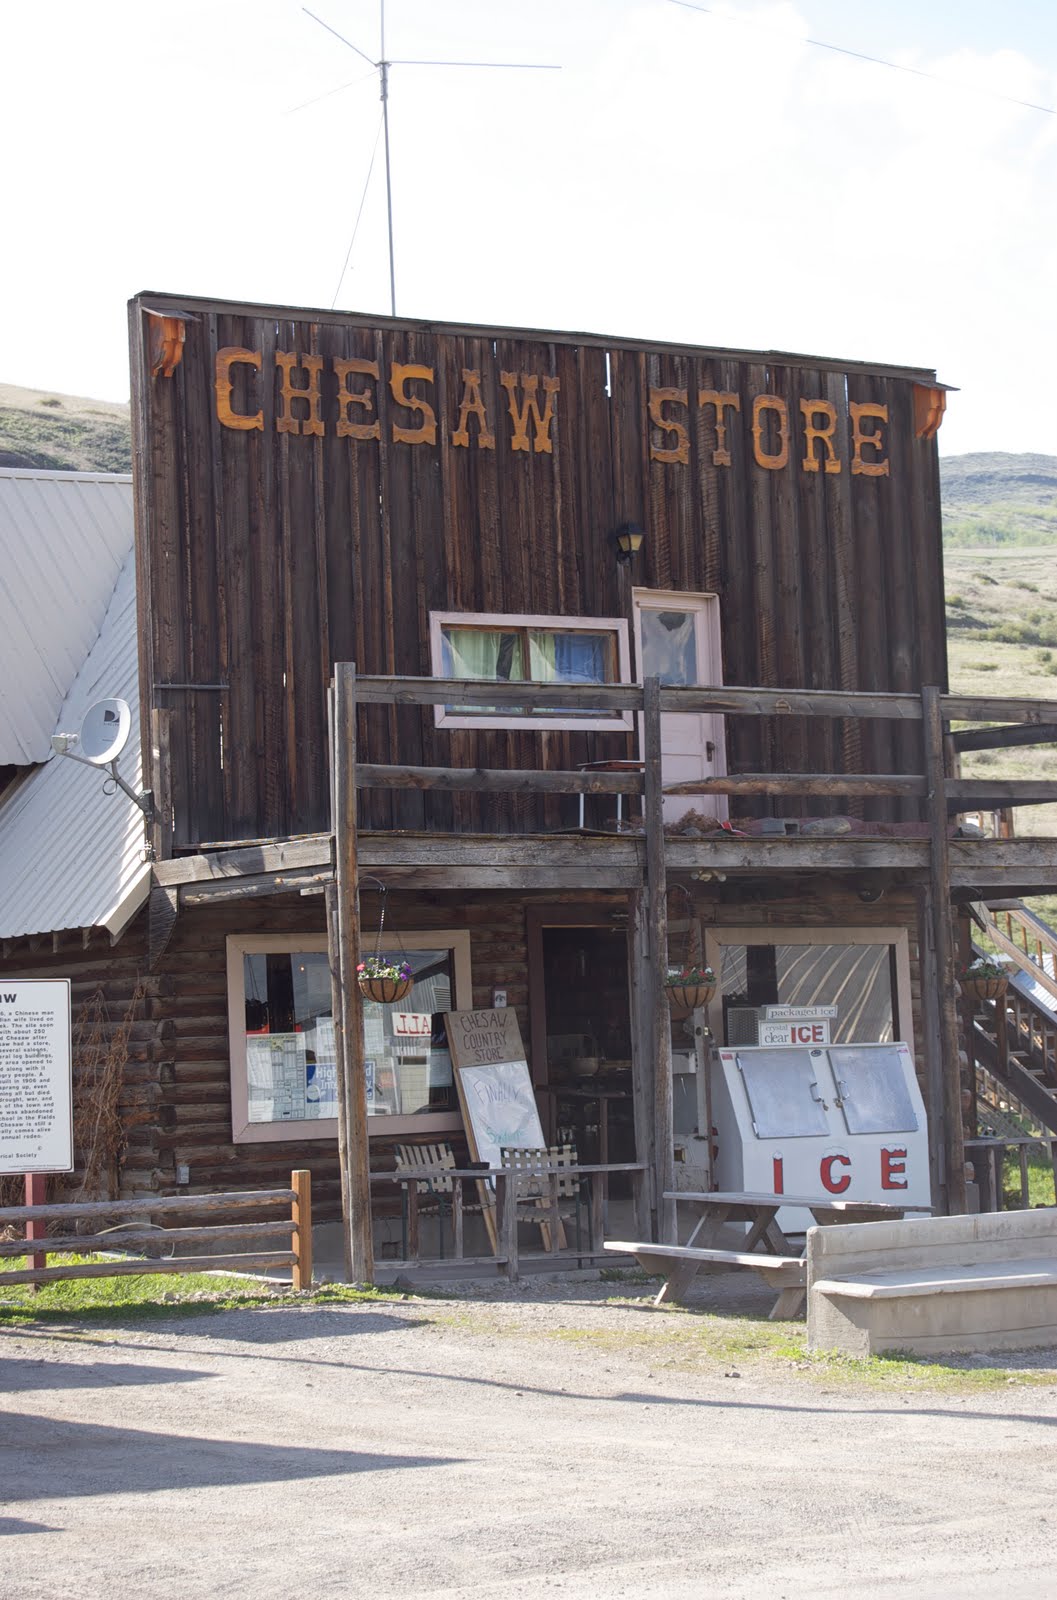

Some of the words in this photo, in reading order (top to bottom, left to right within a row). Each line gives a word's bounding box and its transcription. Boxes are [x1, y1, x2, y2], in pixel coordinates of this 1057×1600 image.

[213, 347, 560, 454] CHESAW
[648, 386, 890, 477] STORE
[460, 1011, 508, 1033] CHESAW
[771, 1008, 817, 1018] packaged
[764, 1032, 789, 1043] clear
[791, 1024, 824, 1044] ICE
[765, 1024, 788, 1032] crystal
[463, 1031, 507, 1050] COUNTRY
[474, 1047, 504, 1061] STORE
[772, 1142, 908, 1195] ICE
